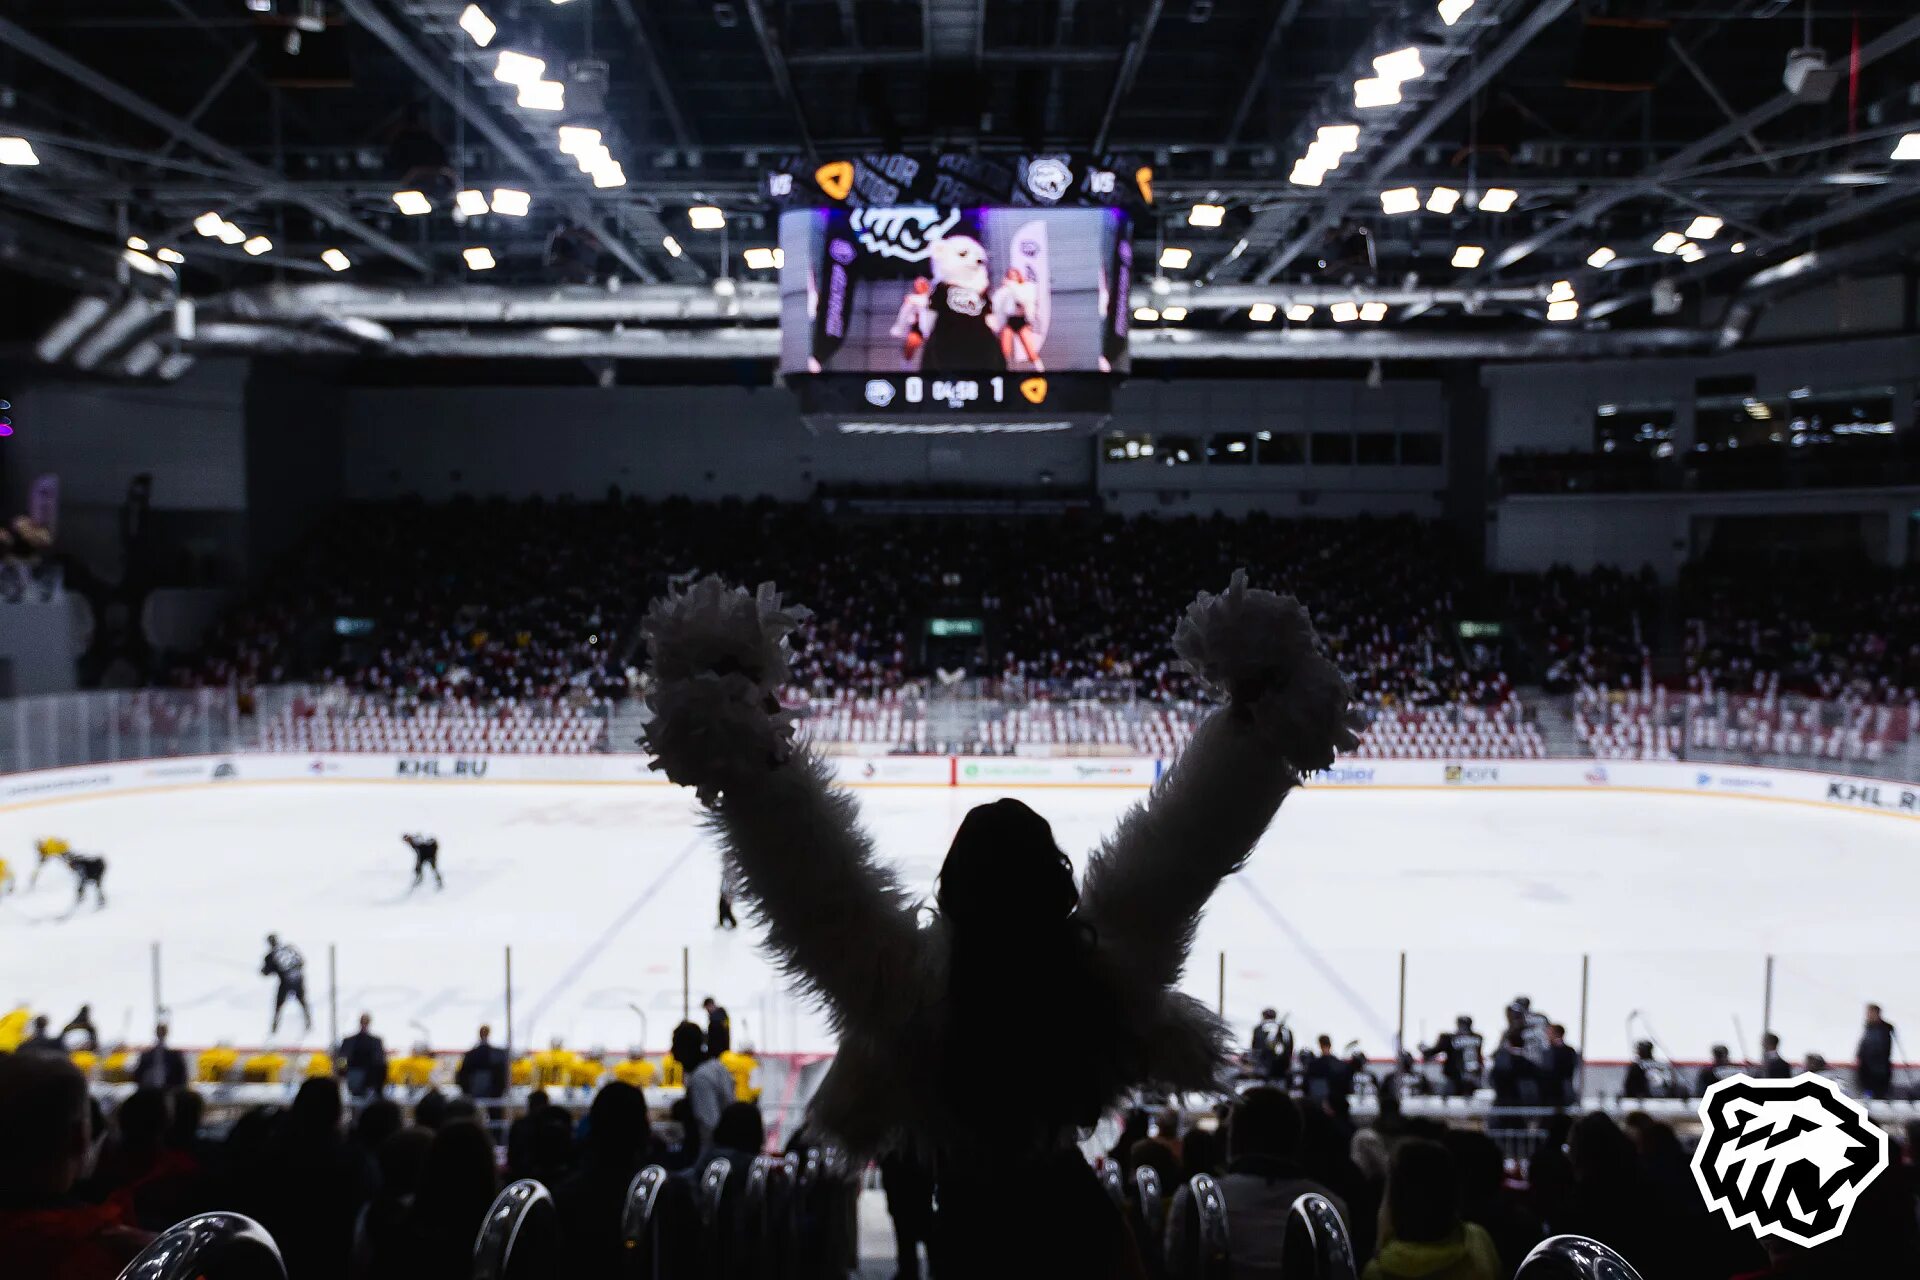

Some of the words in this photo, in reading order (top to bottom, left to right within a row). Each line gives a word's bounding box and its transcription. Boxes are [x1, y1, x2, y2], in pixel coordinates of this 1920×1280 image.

[1091, 172, 1115, 192] VS
[905, 377, 923, 402] 0
[990, 377, 1003, 402] 1
[398, 759, 487, 777] KHL.RU
[1828, 782, 1920, 810] KHL.R
